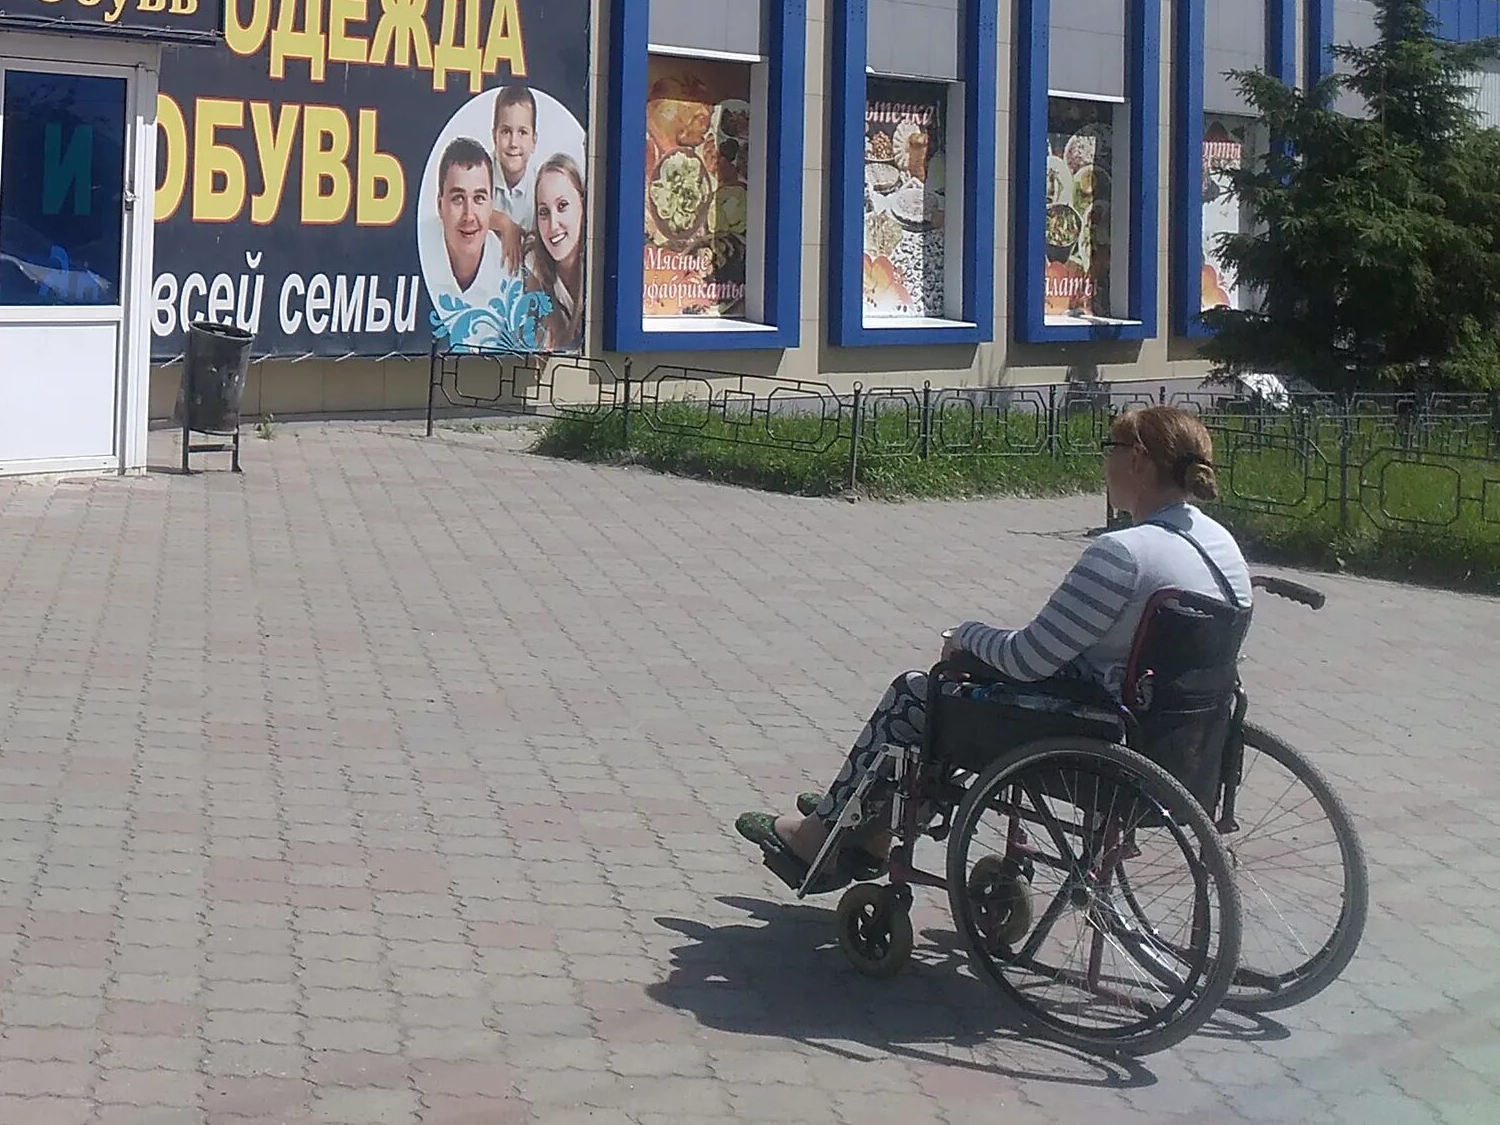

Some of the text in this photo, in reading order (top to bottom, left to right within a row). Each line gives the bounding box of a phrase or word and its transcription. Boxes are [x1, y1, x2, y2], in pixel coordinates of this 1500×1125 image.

[645, 247, 709, 271] Мясные
[151, 251, 265, 337] всей
[279, 273, 420, 335] семьи
[643, 275, 746, 307] фабрикаты
